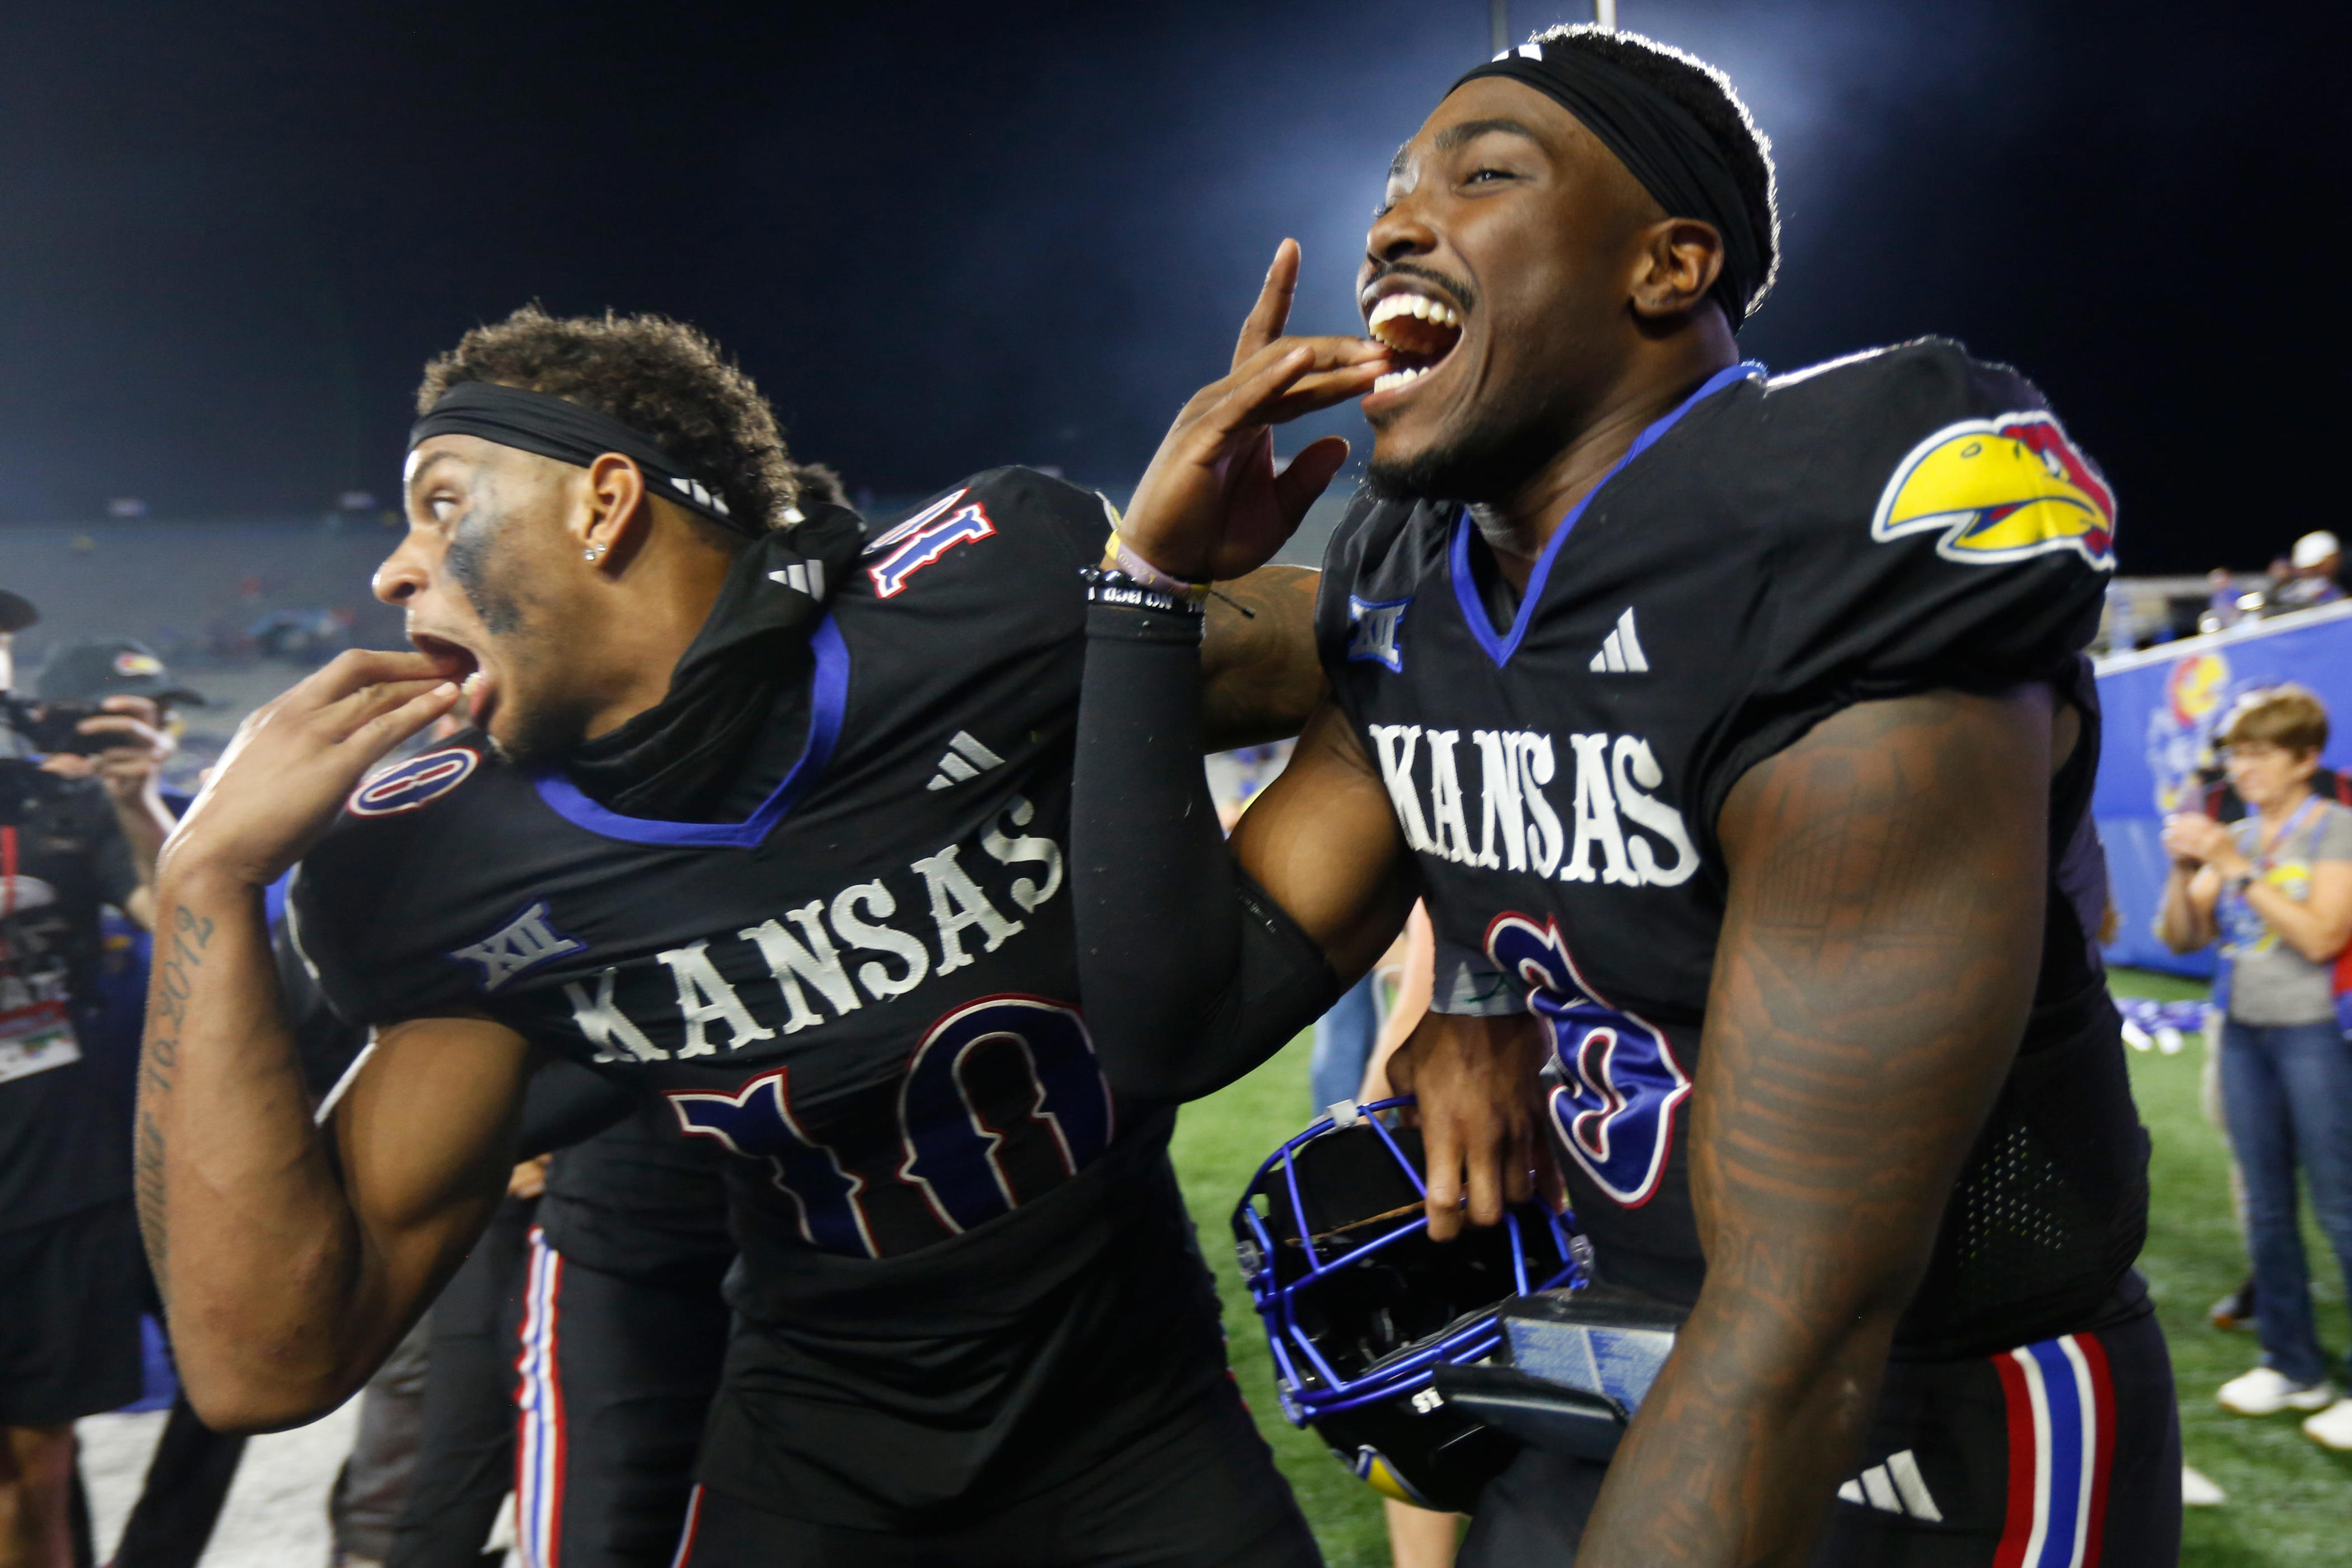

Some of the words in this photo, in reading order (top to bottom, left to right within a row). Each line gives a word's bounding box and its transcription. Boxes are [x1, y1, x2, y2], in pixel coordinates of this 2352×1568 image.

[564, 793, 1064, 1064] KANSAS
[1369, 724, 1701, 887] KANSAS
[662, 992, 1116, 1260] 10
